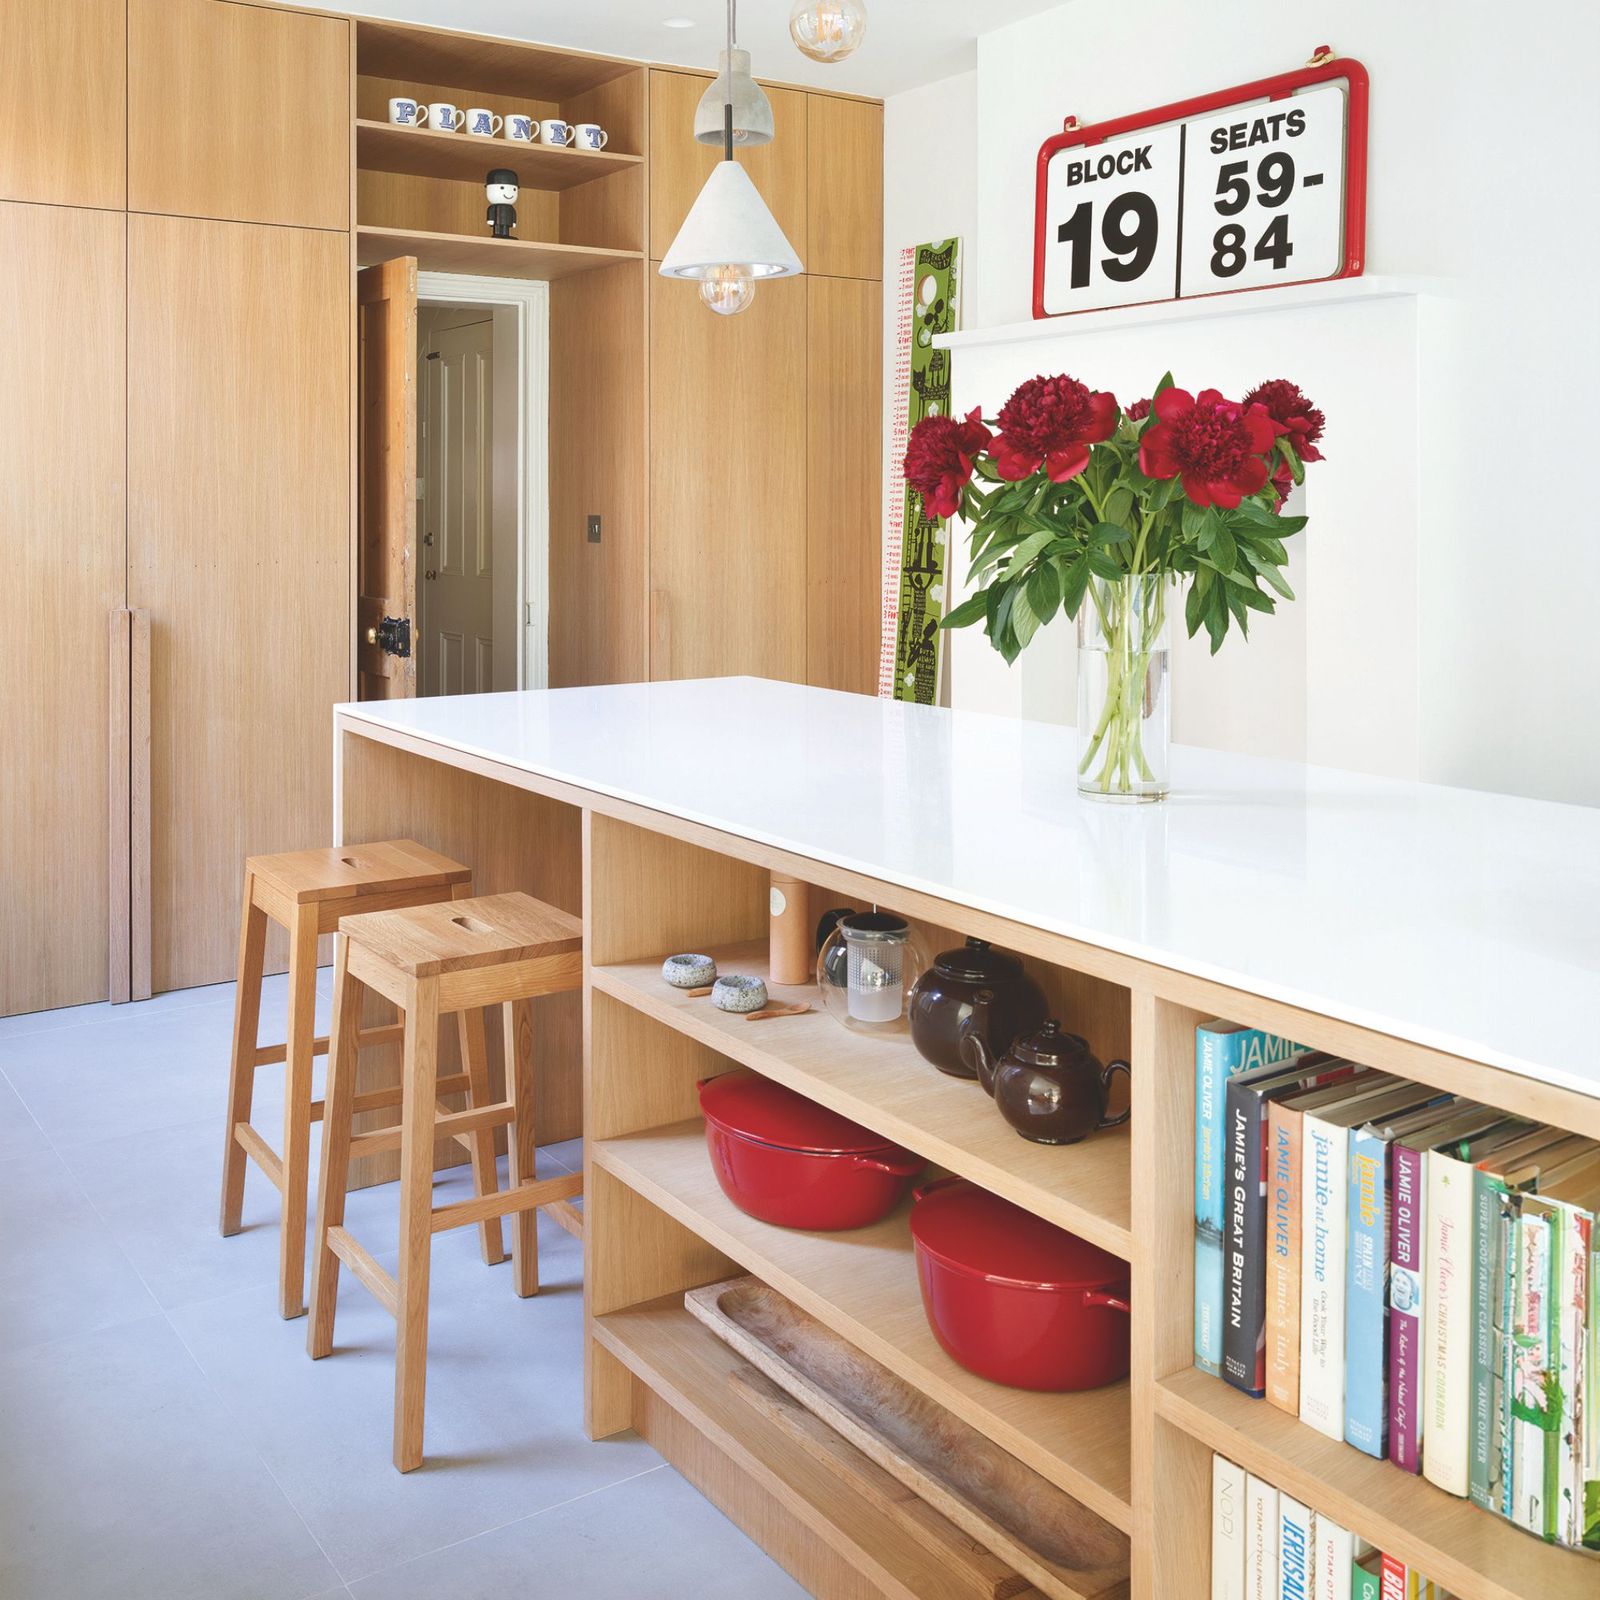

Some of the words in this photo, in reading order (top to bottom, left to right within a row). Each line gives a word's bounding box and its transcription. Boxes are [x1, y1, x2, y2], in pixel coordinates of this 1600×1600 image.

[1210, 109, 1306, 154] SEATS
[1067, 145, 1153, 187] BLOCK
[1057, 191, 1159, 289] 19
[1210, 214, 1293, 278] 84
[1203, 1036, 1213, 1073] JAMIE
[1202, 1075, 1213, 1119] OLIVER
[1235, 1108, 1247, 1181] JAMIE'S
[1277, 1126, 1290, 1183] JAMIE
[1312, 1129, 1333, 1205] jamie
[1399, 1155, 1412, 1204] JAMIE
[1357, 1153, 1381, 1228] jamie
[1479, 1194, 1489, 1230] SUPER
[1233, 1186, 1246, 1248] GREAT
[1275, 1192, 1290, 1257] OLIVER
[1315, 1206, 1327, 1221] at
[1397, 1206, 1411, 1263] OLIVER
[1438, 1217, 1454, 1253] Jamie
[1314, 1225, 1329, 1283] home
[1362, 1234, 1374, 1269] SPAIN
[1230, 1252, 1245, 1328] BRITAIN
[1319, 1290, 1328, 1312] Cook
[1479, 1266, 1488, 1308] FAMILY
[1312, 1314, 1320, 1337] Good
[1319, 1315, 1328, 1336] Your
[1436, 1302, 1448, 1369] CHRISTMAS
[1478, 1311, 1488, 1365] CLASSICS
[1317, 1339, 1328, 1358] Way
[1434, 1370, 1447, 1431] COOKBOOK
[1477, 1382, 1488, 1418] JAMIE
[1477, 1420, 1487, 1464] OLIVER
[1220, 1478, 1233, 1540] NOPI
[1255, 1497, 1263, 1531] YOTAM
[1326, 1540, 1335, 1576] YOTAM
[1362, 1583, 1375, 1600] Co
